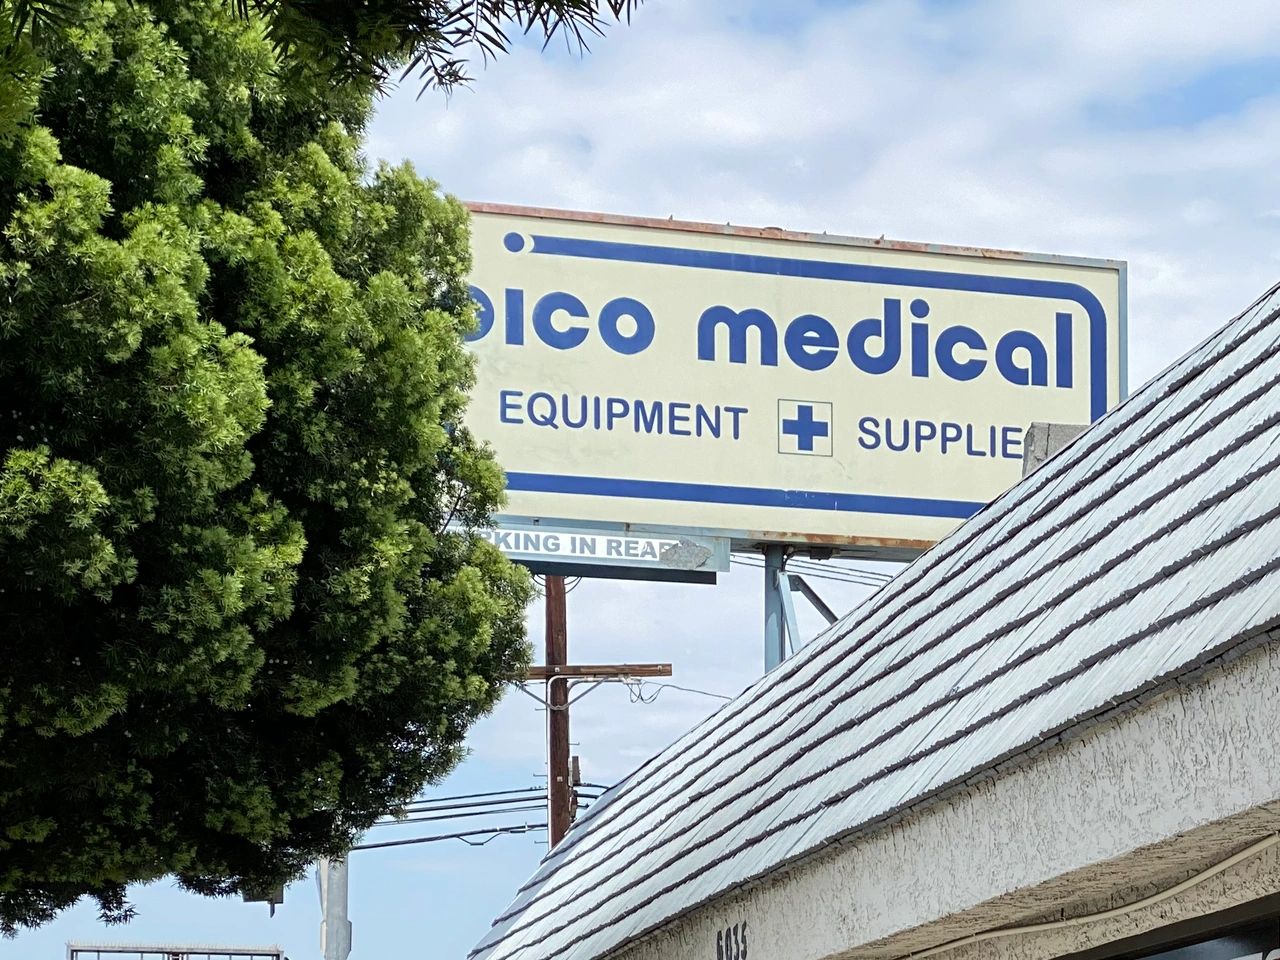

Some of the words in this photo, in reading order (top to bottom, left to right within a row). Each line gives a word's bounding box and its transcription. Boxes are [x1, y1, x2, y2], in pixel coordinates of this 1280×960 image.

[697, 297, 1075, 389] medical
[499, 389, 749, 440] EQUIPMENT
[570, 536, 596, 555] IN
